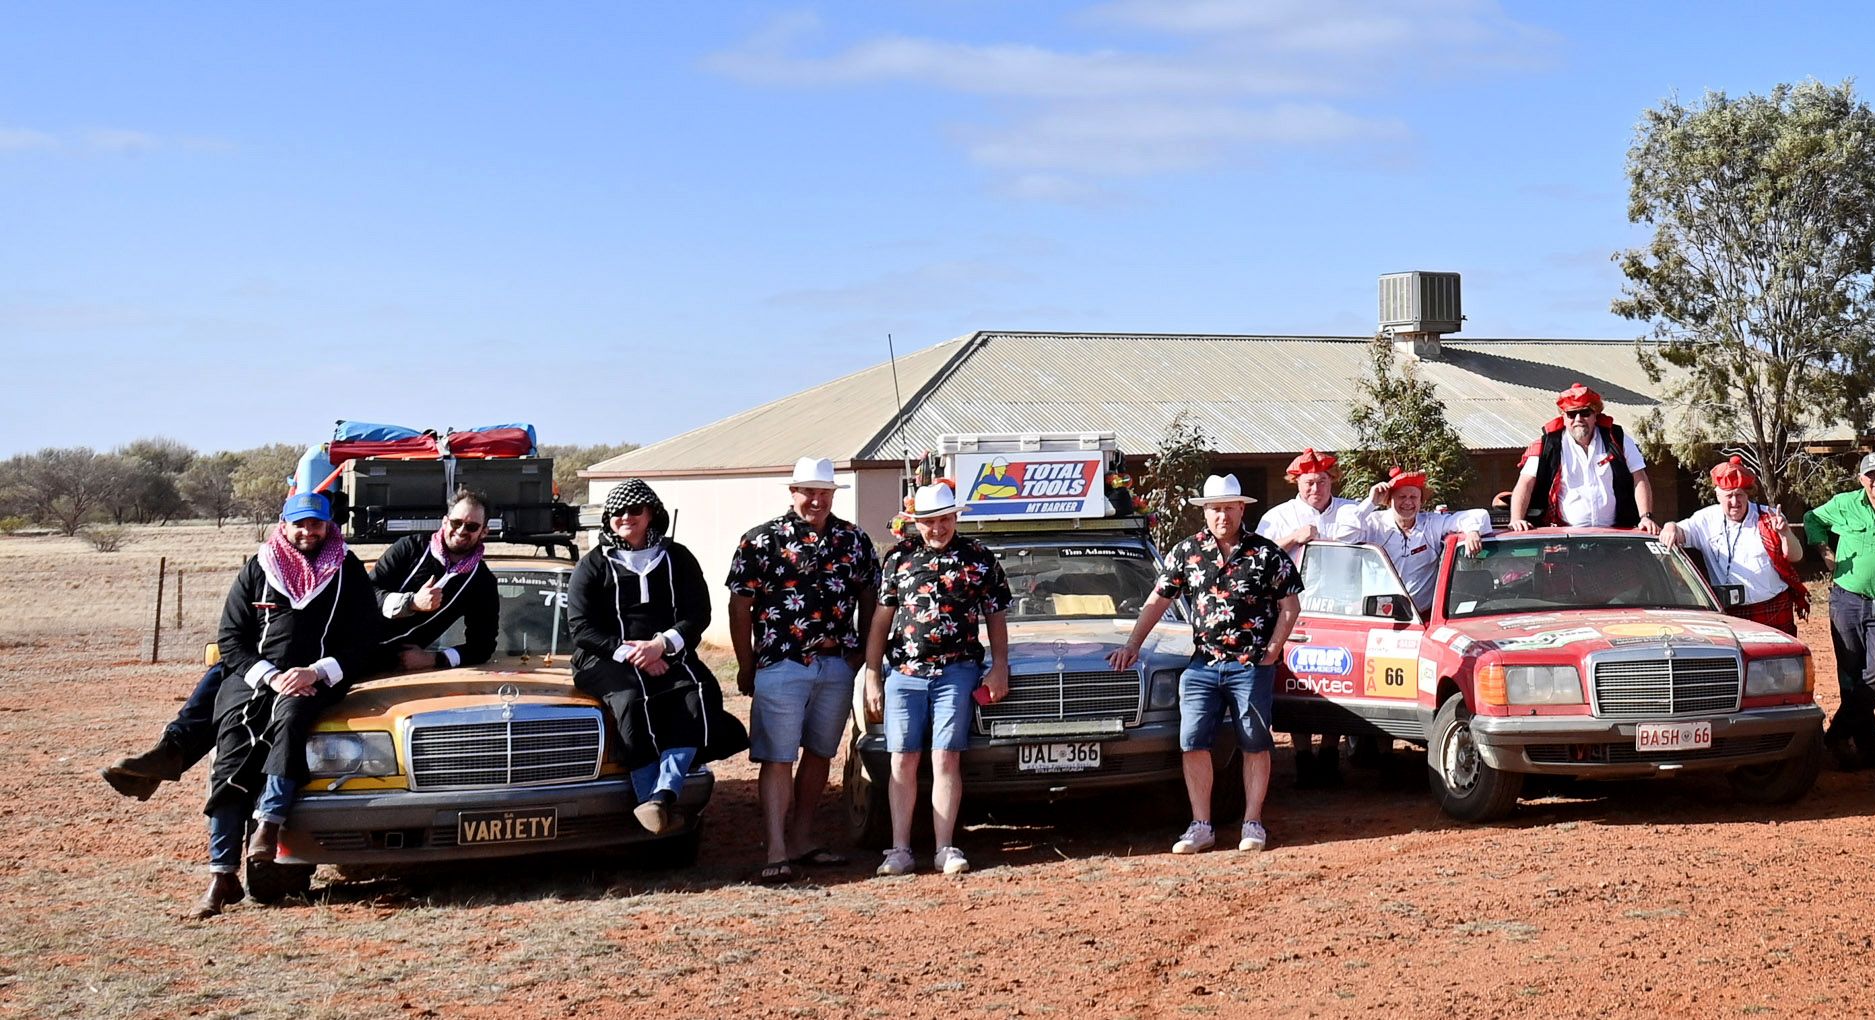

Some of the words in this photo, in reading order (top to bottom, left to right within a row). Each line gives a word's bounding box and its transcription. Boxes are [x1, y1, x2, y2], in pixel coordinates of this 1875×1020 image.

[1023, 463, 1084, 480] TOTAL
[1021, 479, 1086, 497] TOOLS
[1026, 503, 1040, 514] MT
[1041, 501, 1078, 513] BARKER
[1061, 548, 1083, 556] Tim
[1084, 548, 1116, 556] Adams
[511, 575, 547, 586] Adams
[1285, 674, 1354, 694] polytec
[1385, 667, 1404, 687] 66
[1640, 729, 1680, 746] BASH
[1694, 727, 1709, 744] 66
[1021, 743, 1058, 764] UAL
[1067, 742, 1098, 762] 366
[463, 816, 553, 842] VARIETY
